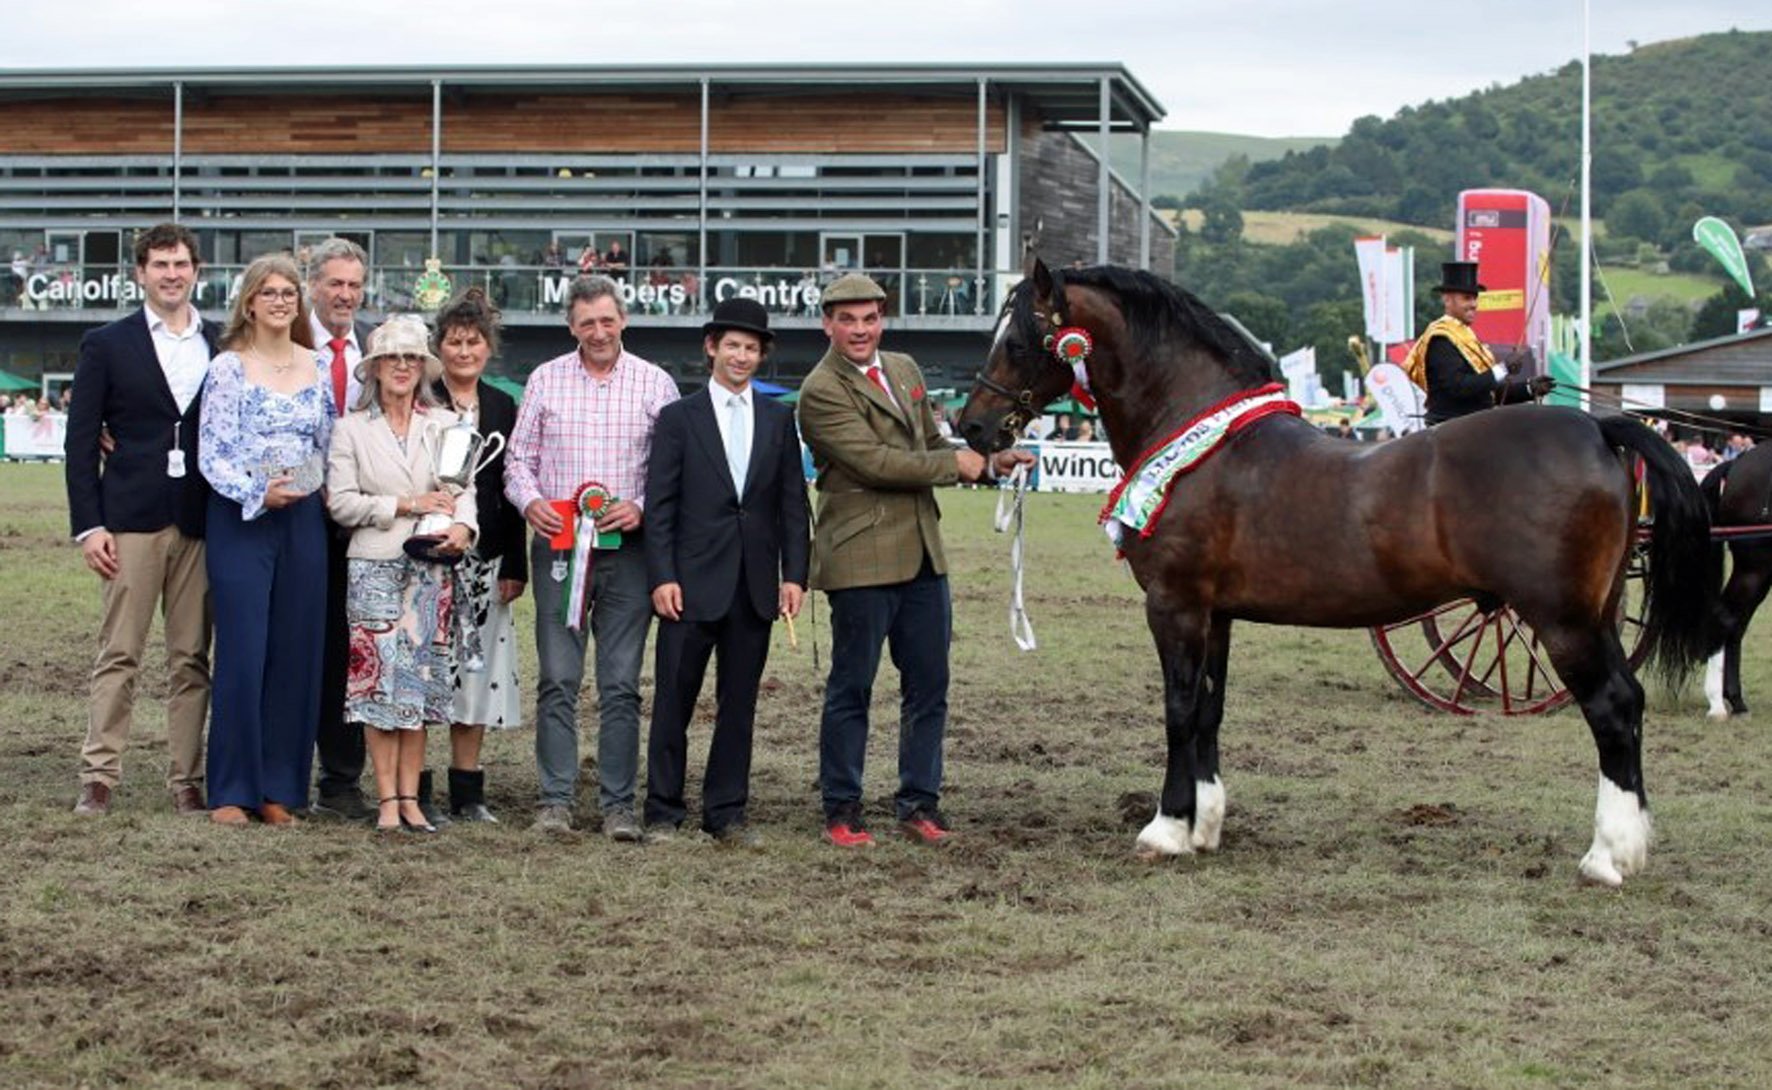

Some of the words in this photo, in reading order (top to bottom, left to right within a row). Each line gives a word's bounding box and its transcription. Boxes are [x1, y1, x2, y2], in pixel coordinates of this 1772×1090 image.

[27, 273, 146, 300] Canolfa
[543, 276, 687, 304] Mbers
[714, 277, 822, 306] Centre
